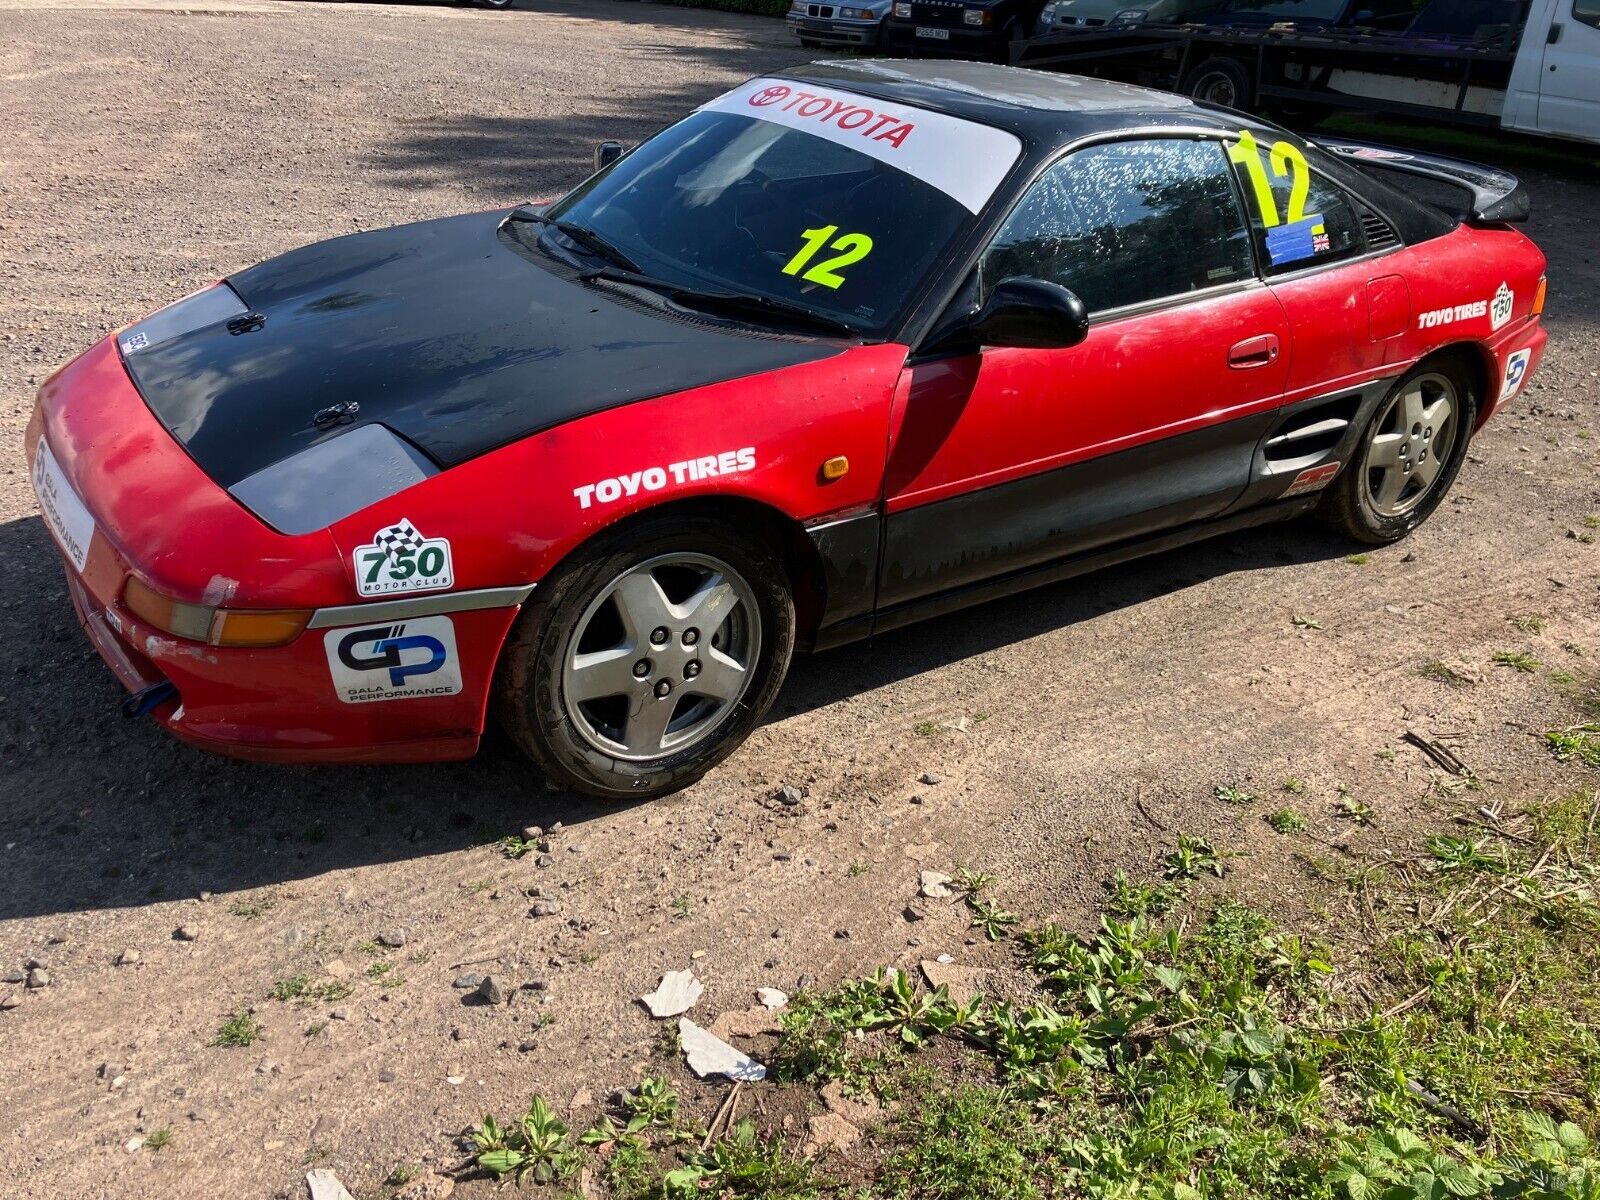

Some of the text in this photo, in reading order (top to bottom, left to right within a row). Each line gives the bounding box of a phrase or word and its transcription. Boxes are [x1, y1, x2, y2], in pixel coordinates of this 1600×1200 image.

[781, 92, 915, 149] TOYOTA
[1227, 130, 1325, 235] 12
[781, 224, 873, 289] 12
[1418, 300, 1488, 329] TOYO TIRES
[1493, 296, 1512, 322] 750
[573, 446, 757, 510] TOYO TIRES
[42, 487, 84, 566] PERFORMANCE
[362, 546, 445, 584] 750
[364, 577, 448, 592] MOTOR CLUB
[347, 686, 385, 695] GALA
[350, 687, 454, 701] PERFORMANCE
